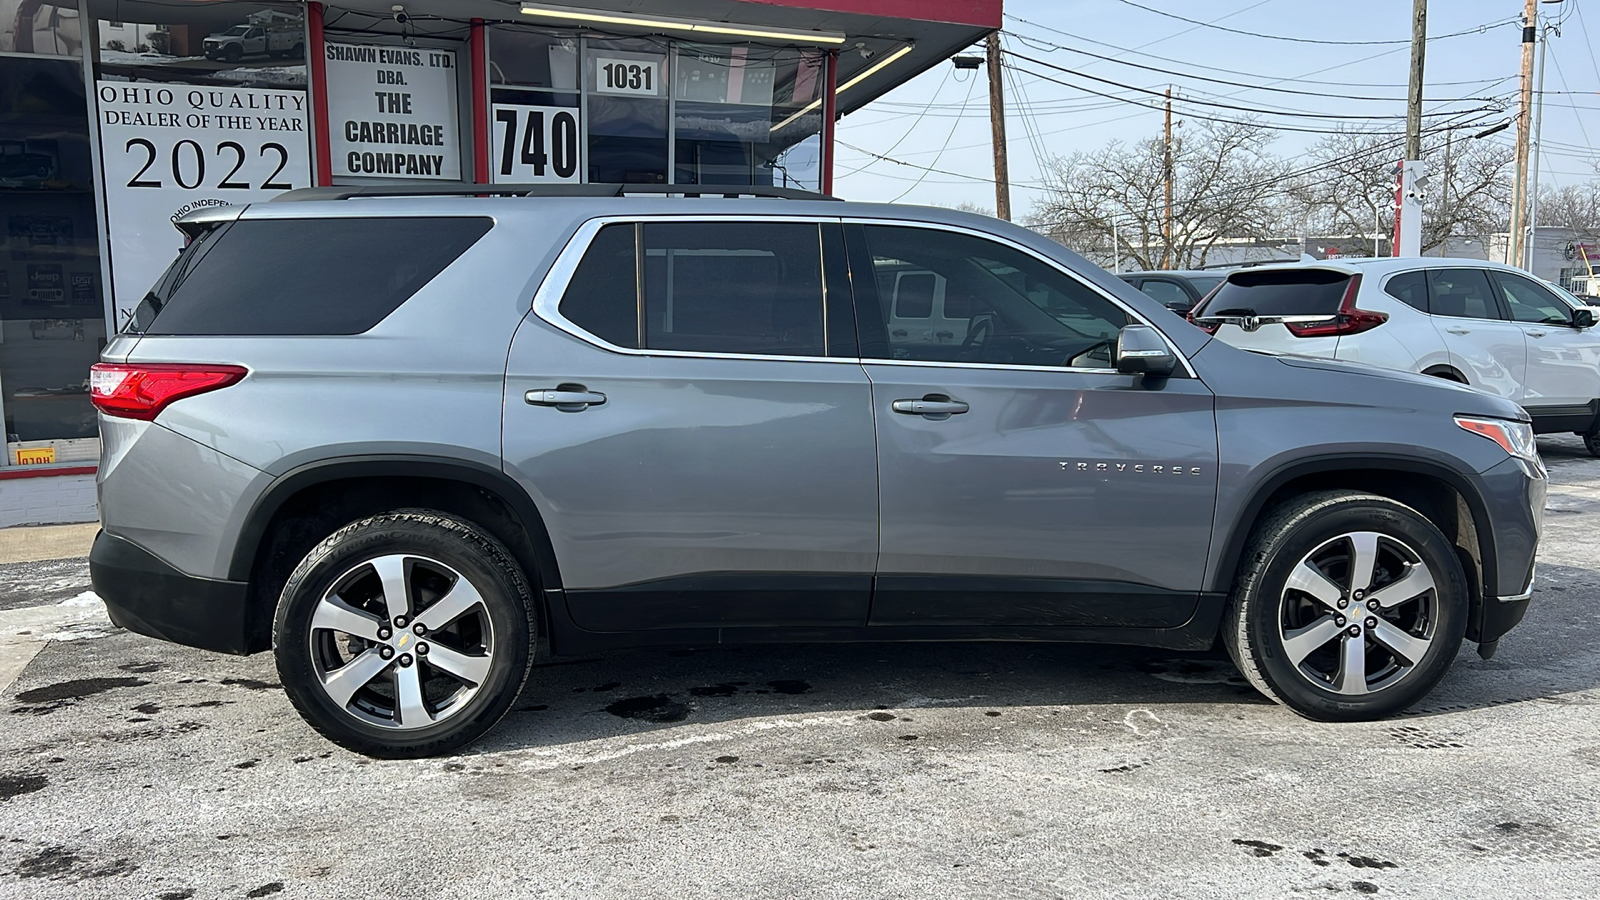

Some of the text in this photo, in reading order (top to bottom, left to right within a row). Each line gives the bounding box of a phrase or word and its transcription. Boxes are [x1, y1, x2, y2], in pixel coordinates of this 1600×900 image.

[326, 45, 454, 68] SHAWN EVANS. LTD.
[377, 70, 408, 85] DBA.
[603, 63, 652, 90] 1031
[100, 87, 304, 110] OHIO QUALITY
[375, 92, 412, 114] THE
[105, 111, 303, 131] DEALER OF THE YEAR
[345, 120, 444, 146] CARRIAGE
[496, 109, 577, 178] 740
[125, 138, 292, 190] 2022
[347, 151, 443, 176] COMPANY
[170, 205, 191, 222] OHIO
[30, 271, 60, 282] Jeep
[1059, 461, 1201, 475] TRAVERSE
